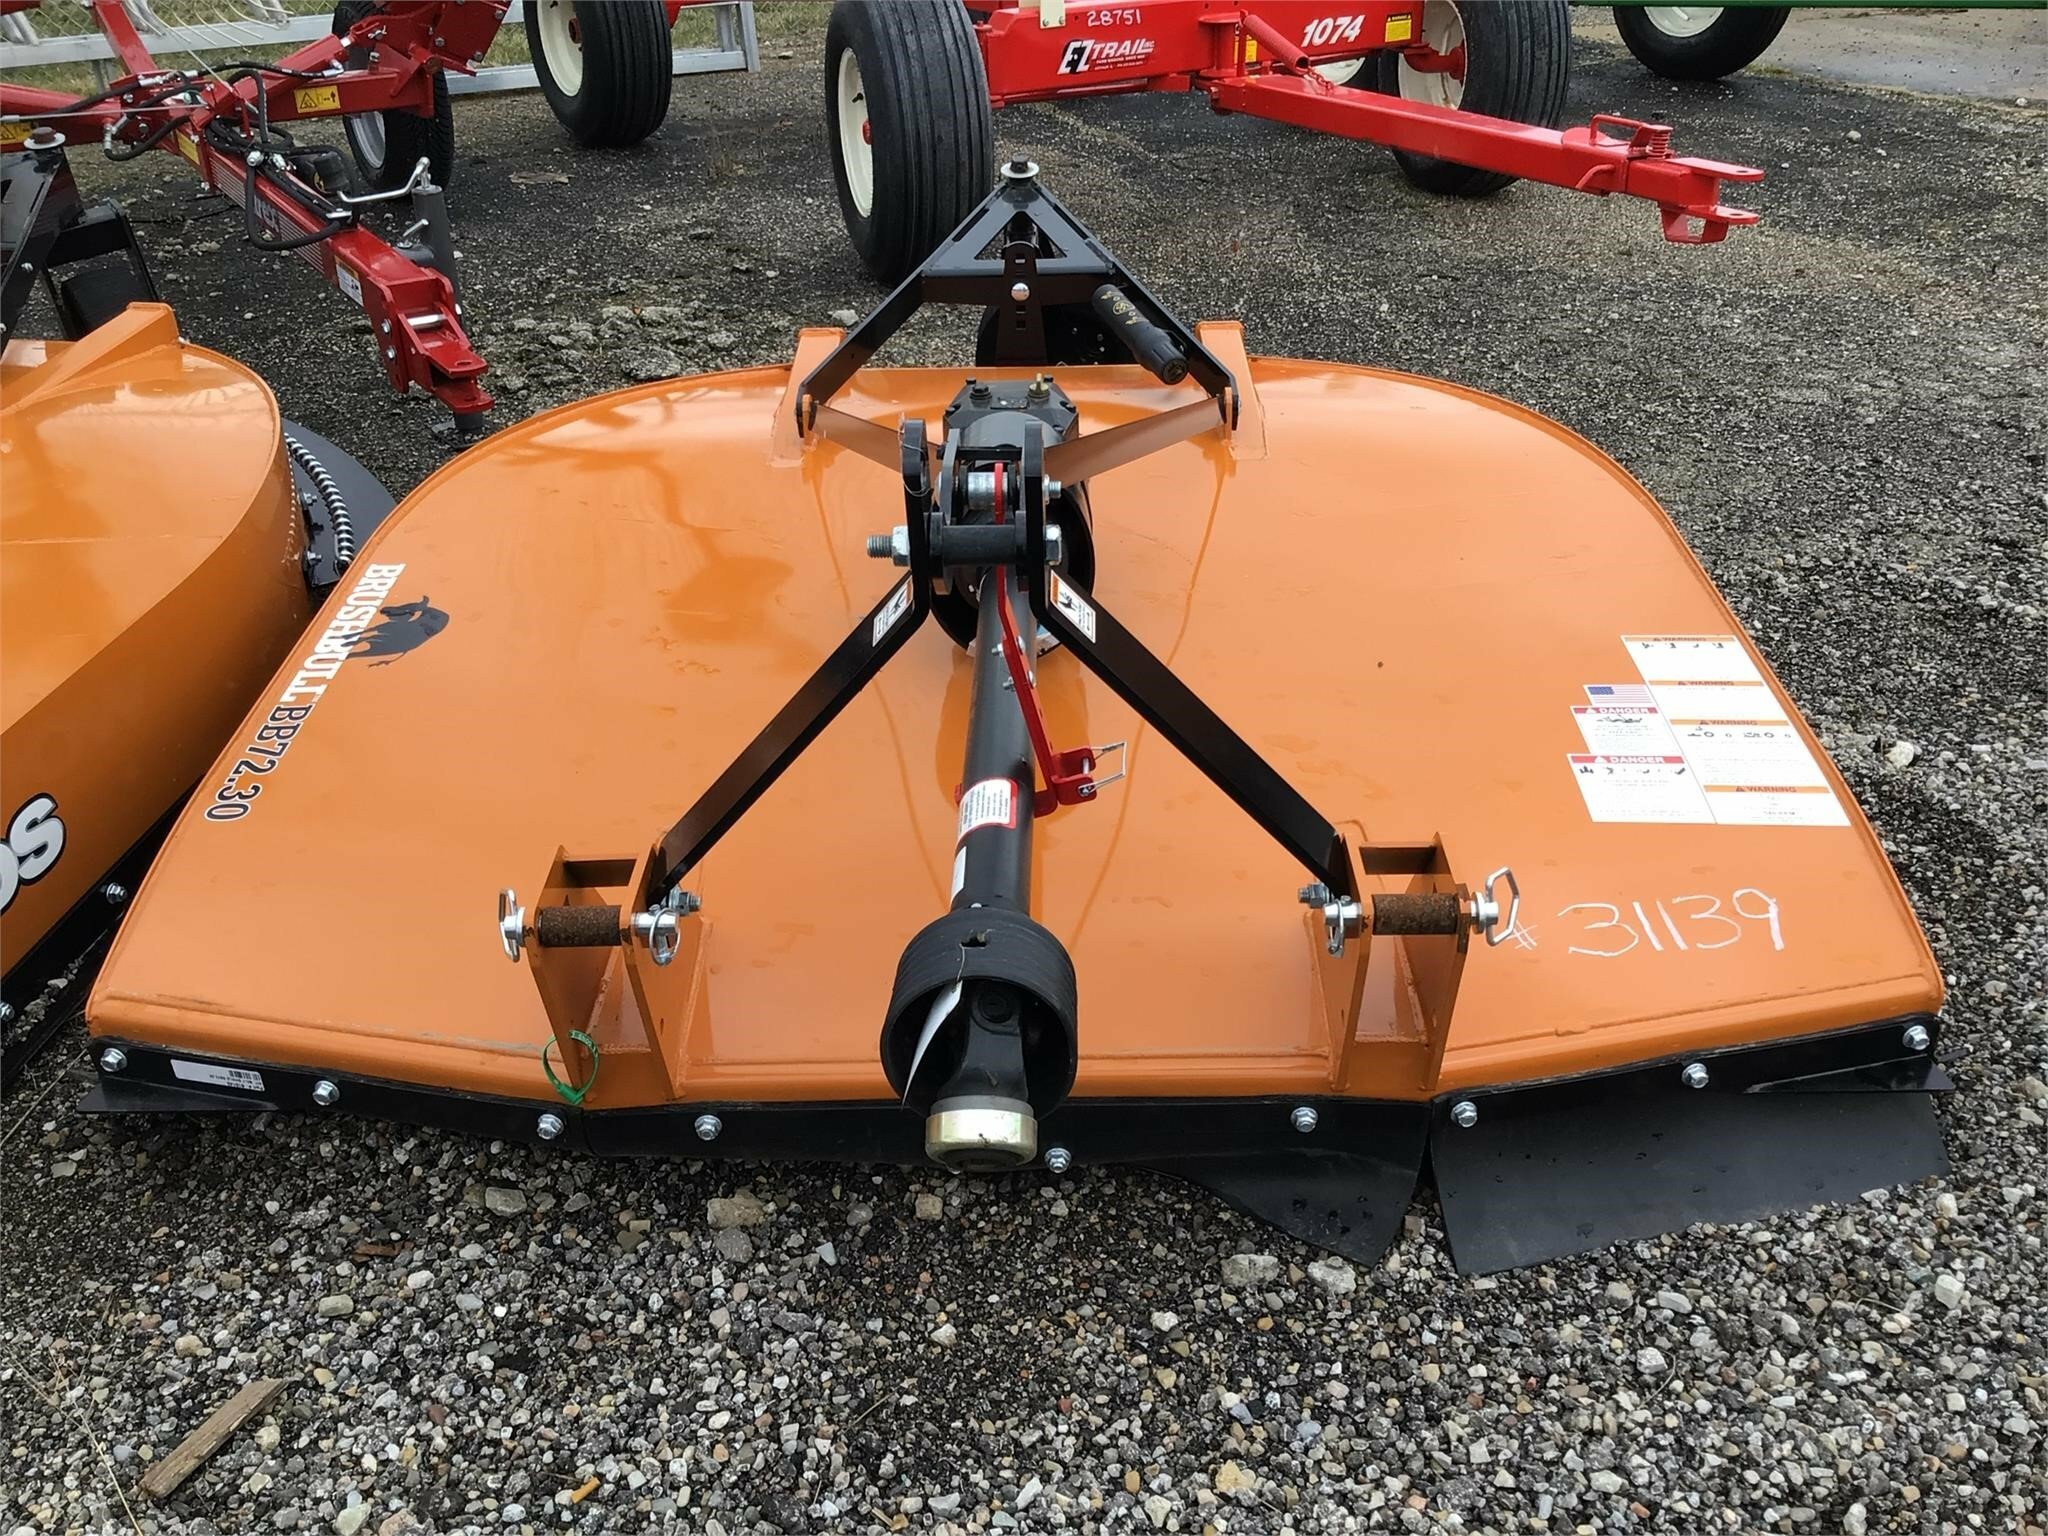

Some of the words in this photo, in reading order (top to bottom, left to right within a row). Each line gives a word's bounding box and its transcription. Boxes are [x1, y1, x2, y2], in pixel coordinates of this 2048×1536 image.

[1086, 8, 1142, 27] 28751
[1300, 14, 1366, 48] 1074
[1091, 38, 1154, 60] TRAIL
[204, 702, 317, 822] BB72.30
[1610, 755, 1665, 764] DANGER
[1557, 887, 1785, 957] 31139
